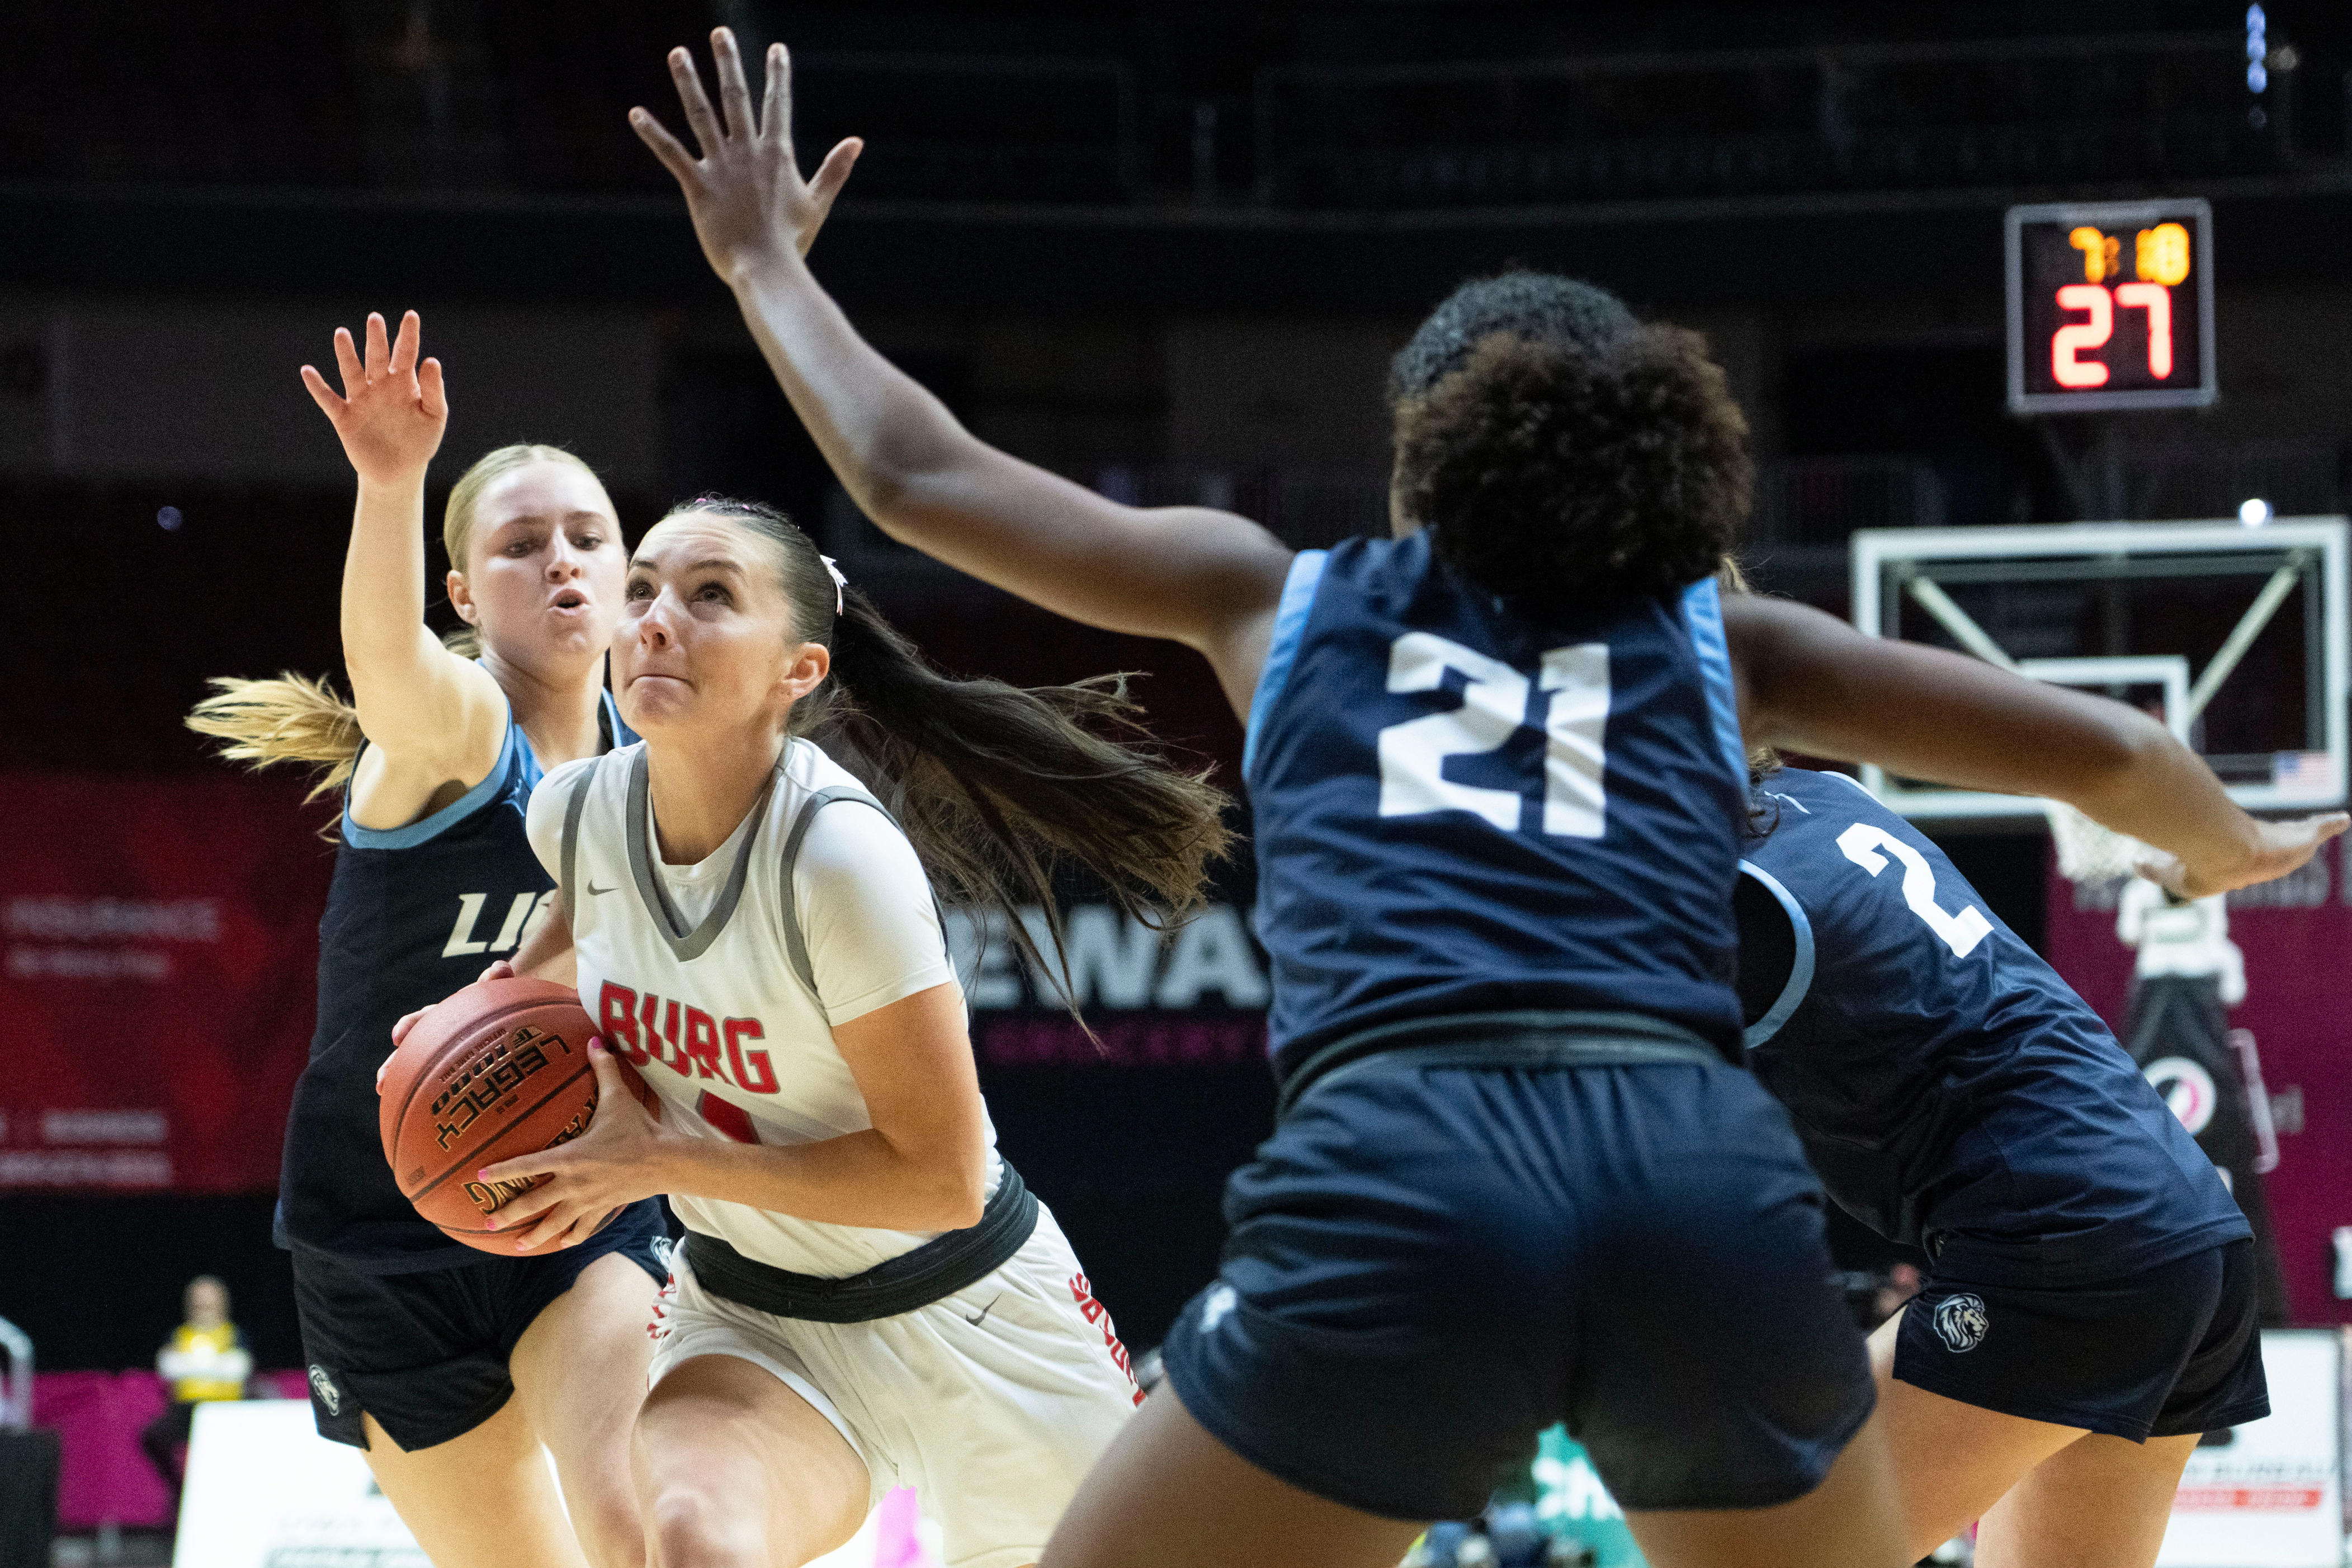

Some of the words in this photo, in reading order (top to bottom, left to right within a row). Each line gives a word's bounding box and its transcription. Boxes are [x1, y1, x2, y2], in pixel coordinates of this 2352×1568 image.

[2051, 281, 2174, 389] 27
[1377, 631, 1612, 839] 21
[1835, 822, 1995, 959] 2
[949, 900, 1269, 1010] EWA
[434, 1033, 571, 1152] LEGACY
[598, 979, 781, 1094] BURG
